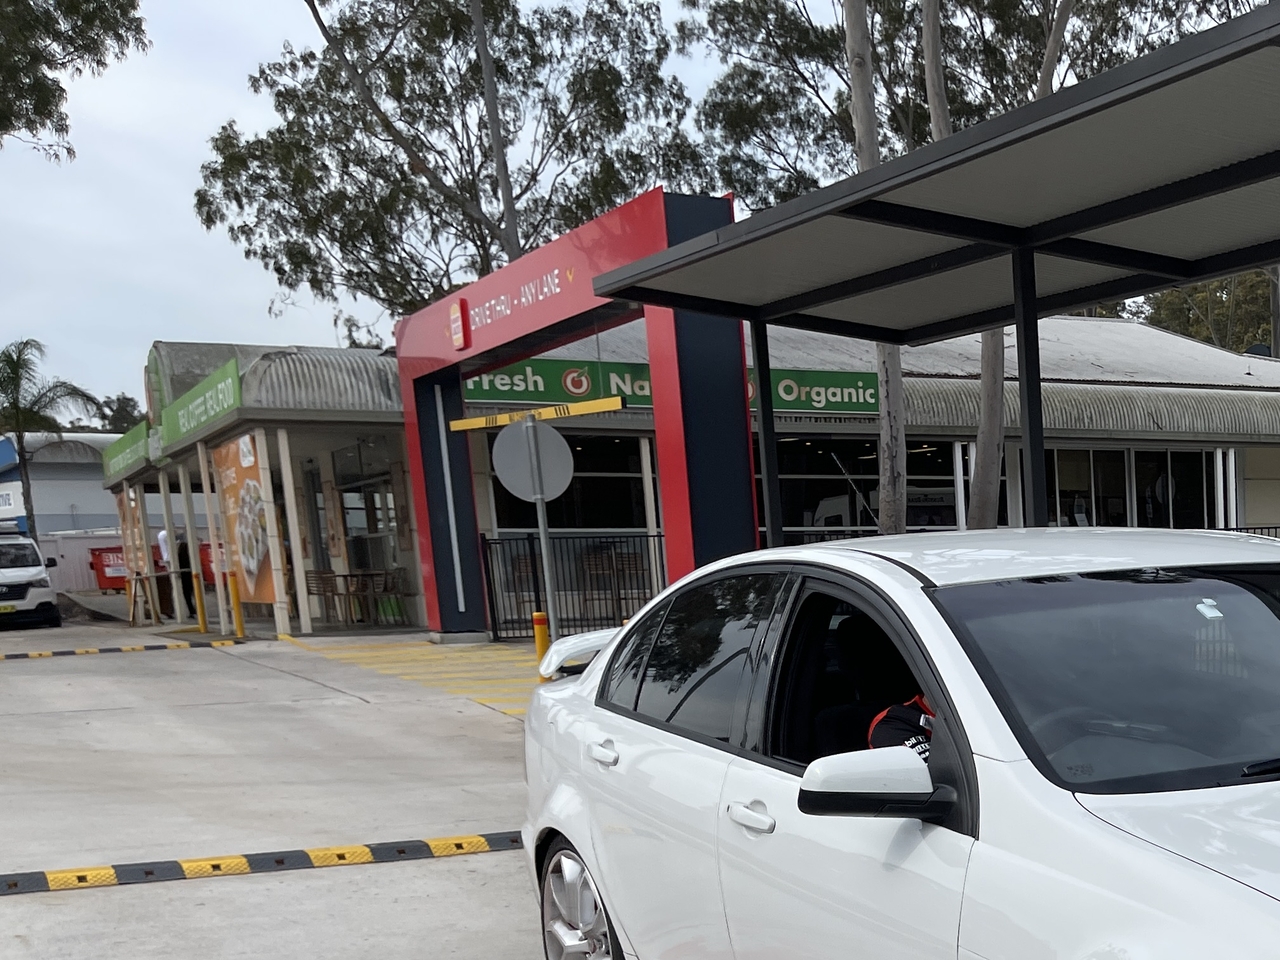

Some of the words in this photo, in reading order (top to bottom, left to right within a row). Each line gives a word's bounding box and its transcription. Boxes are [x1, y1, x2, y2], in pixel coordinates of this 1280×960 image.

[470, 302, 492, 331] DRIVE
[491, 294, 511, 320] THRU
[520, 279, 538, 309] ANY
[537, 268, 561, 301] LANE
[466, 366, 545, 392] Fresh
[609, 372, 650, 396] Na
[777, 378, 876, 408] Organic
